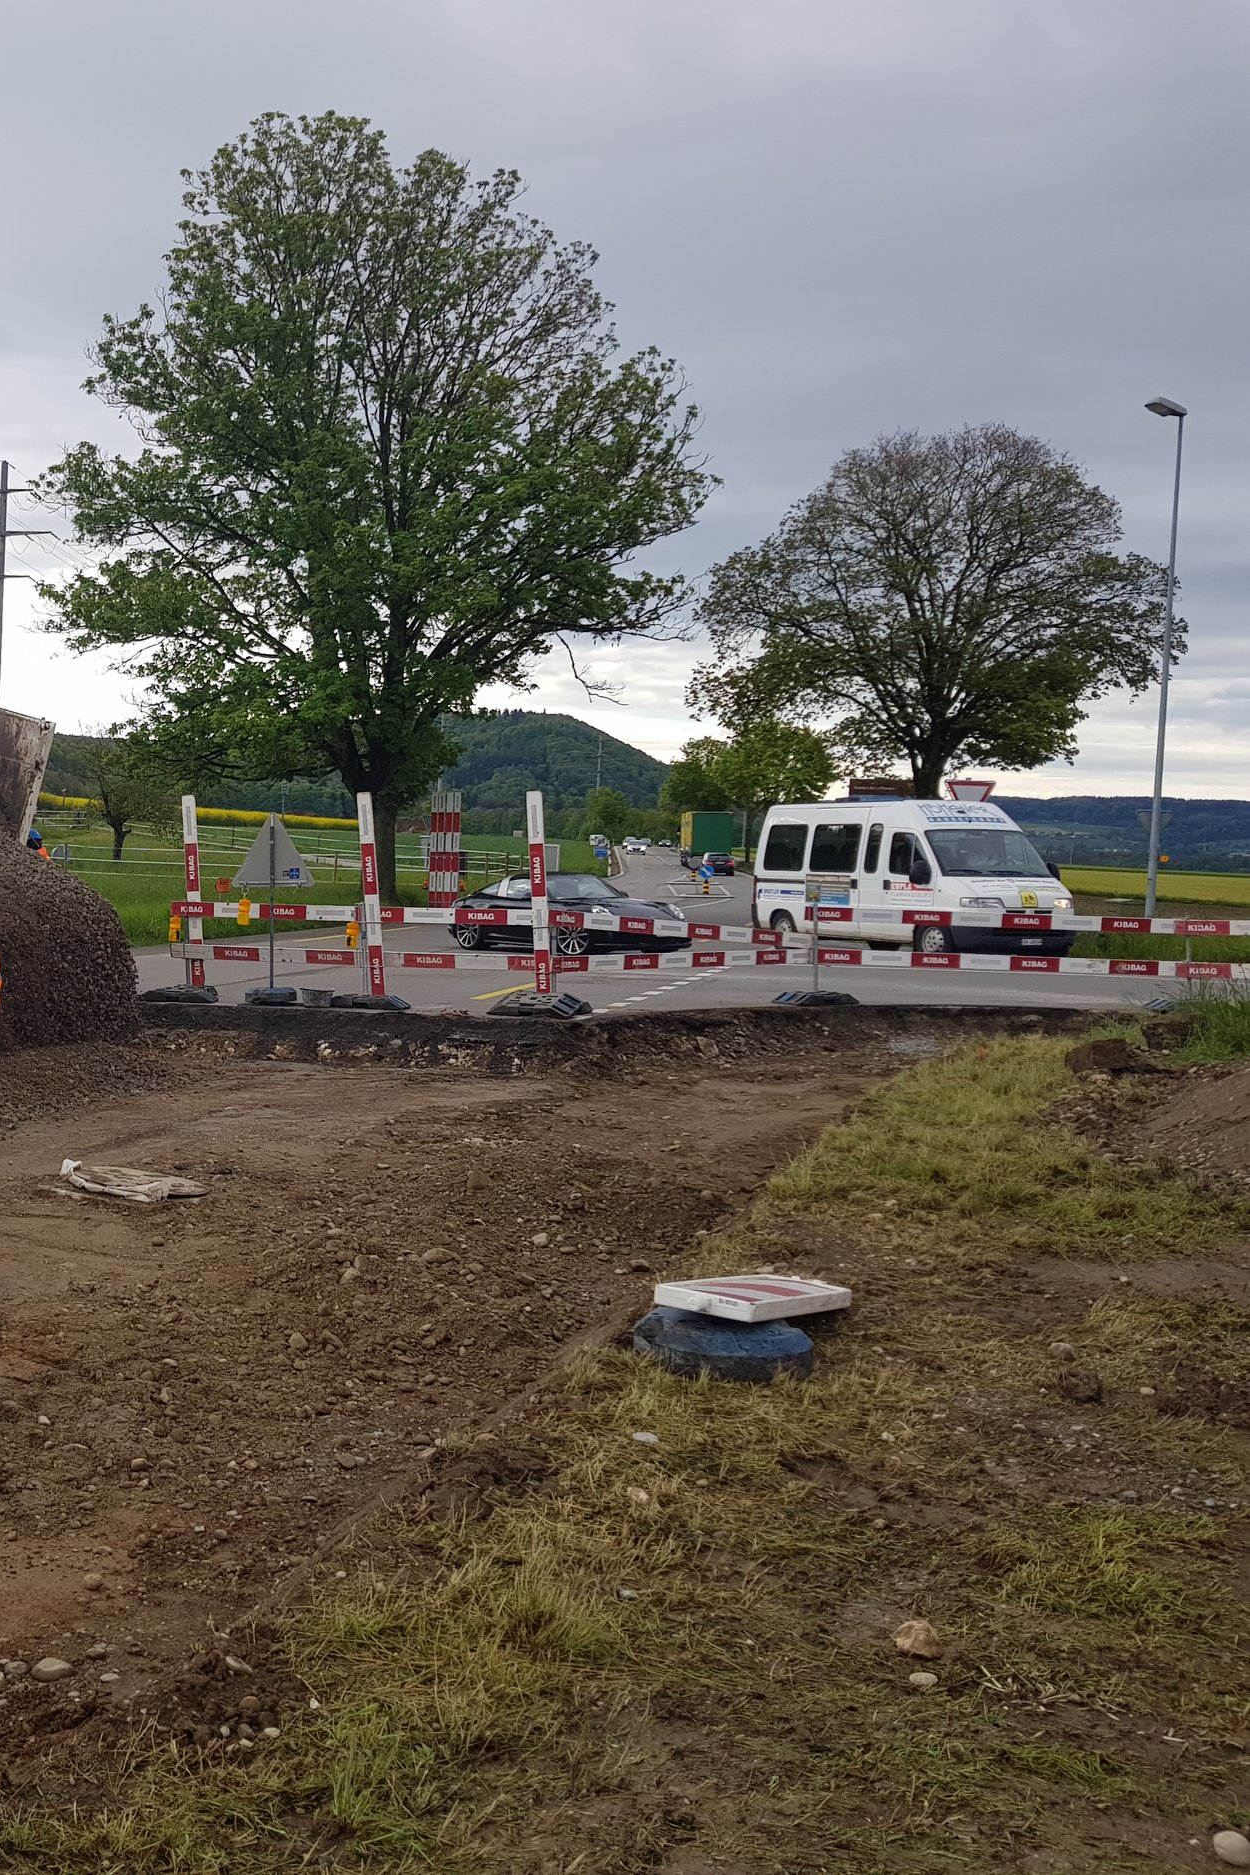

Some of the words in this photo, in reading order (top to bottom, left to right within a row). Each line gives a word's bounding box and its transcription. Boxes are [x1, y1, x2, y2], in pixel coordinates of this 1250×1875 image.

[533, 856, 541, 884] KIBAG
[180, 905, 204, 913] KIBAG
[467, 912, 495, 921] KIBAG
[914, 913, 940, 922] KIBAG
[1013, 917, 1040, 925] KIBAG
[627, 921, 646, 930] KIBAG
[1113, 921, 1139, 929] KIBAG
[1187, 924, 1216, 932] KIBAG
[695, 927, 713, 936] KIBAG
[759, 933, 776, 942] KIBAG
[224, 950, 249, 958] KIBAG
[317, 953, 343, 962] KIBAG
[824, 952, 850, 961] KIBAG
[416, 956, 443, 965] KIBAG
[632, 957, 651, 967] KIBAG
[700, 955, 718, 964] KIBAG
[923, 956, 949, 965] KIBAG
[1022, 960, 1048, 969] KIBAG
[1121, 963, 1147, 972] KIBAG
[1189, 967, 1218, 975] KIBAG
[538, 962, 547, 990] KIBAG
